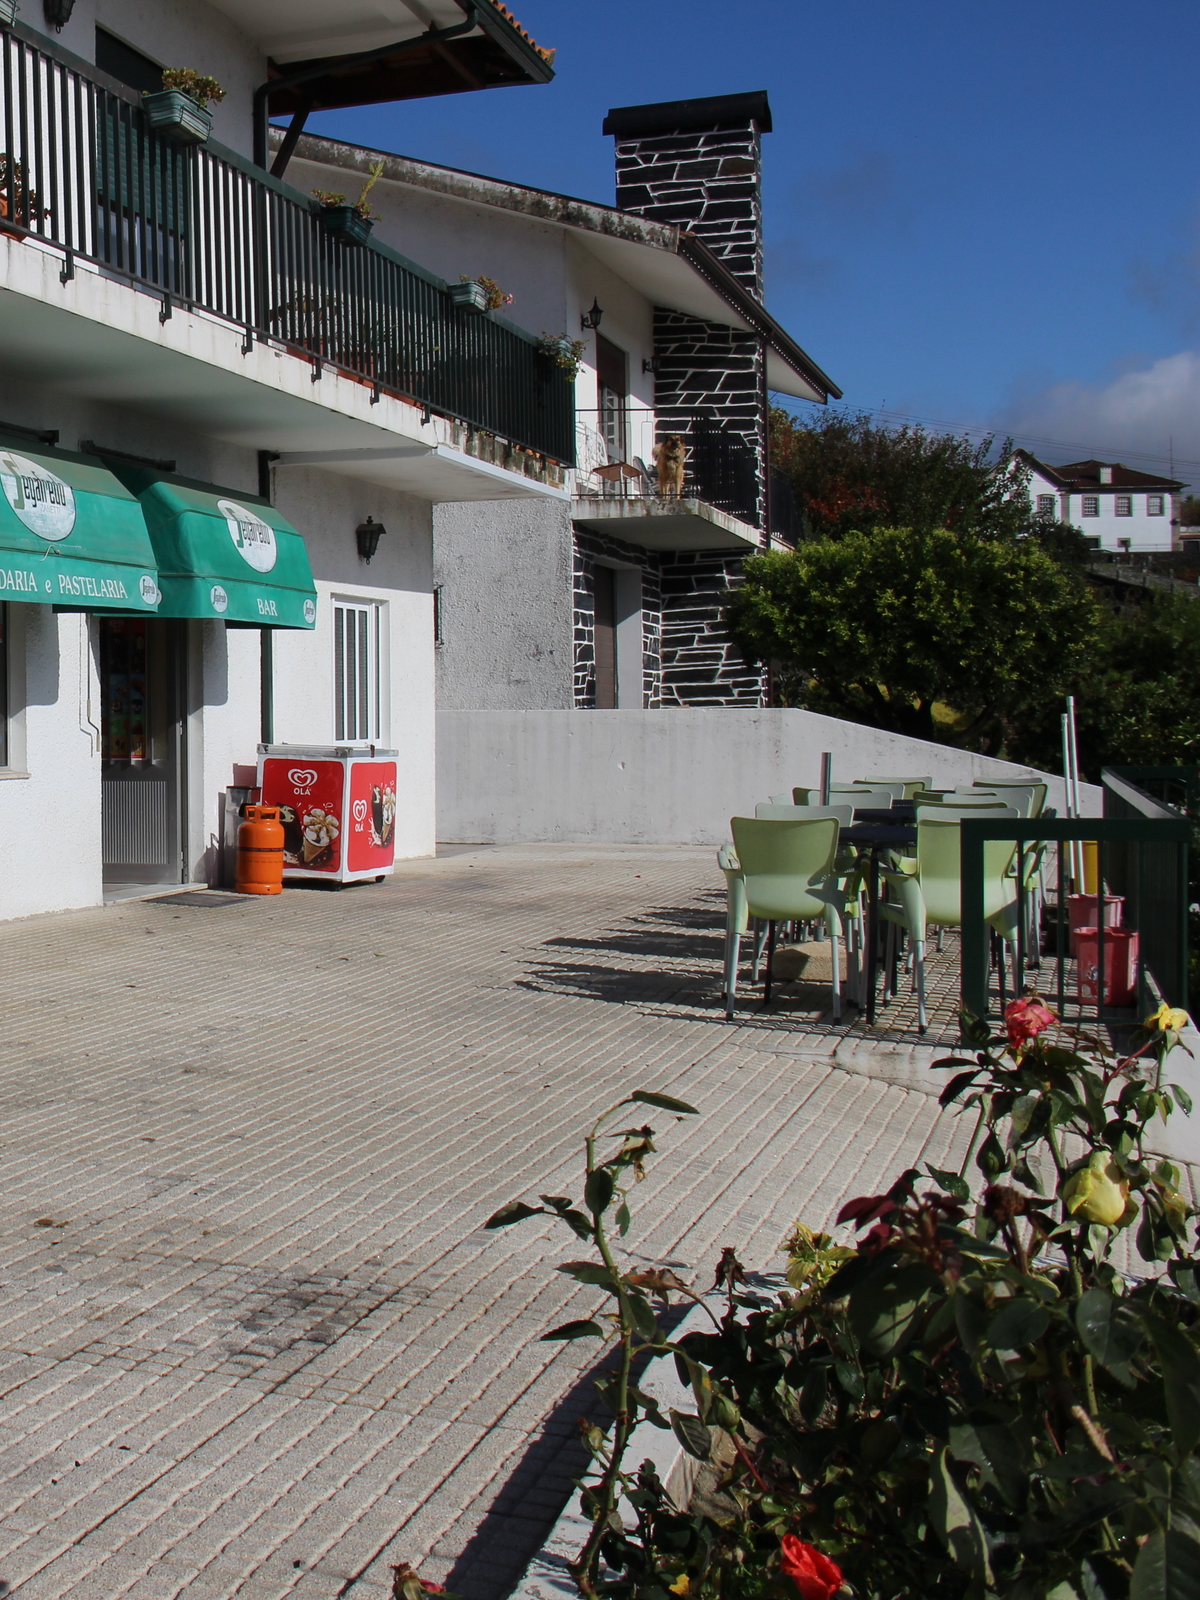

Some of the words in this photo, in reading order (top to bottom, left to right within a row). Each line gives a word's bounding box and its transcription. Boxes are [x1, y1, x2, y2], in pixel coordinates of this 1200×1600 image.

[45, 580, 52, 593] e
[58, 574, 128, 599] PASTELARIA
[256, 598, 278, 616] BAR
[293, 786, 311, 796] OLÁ
